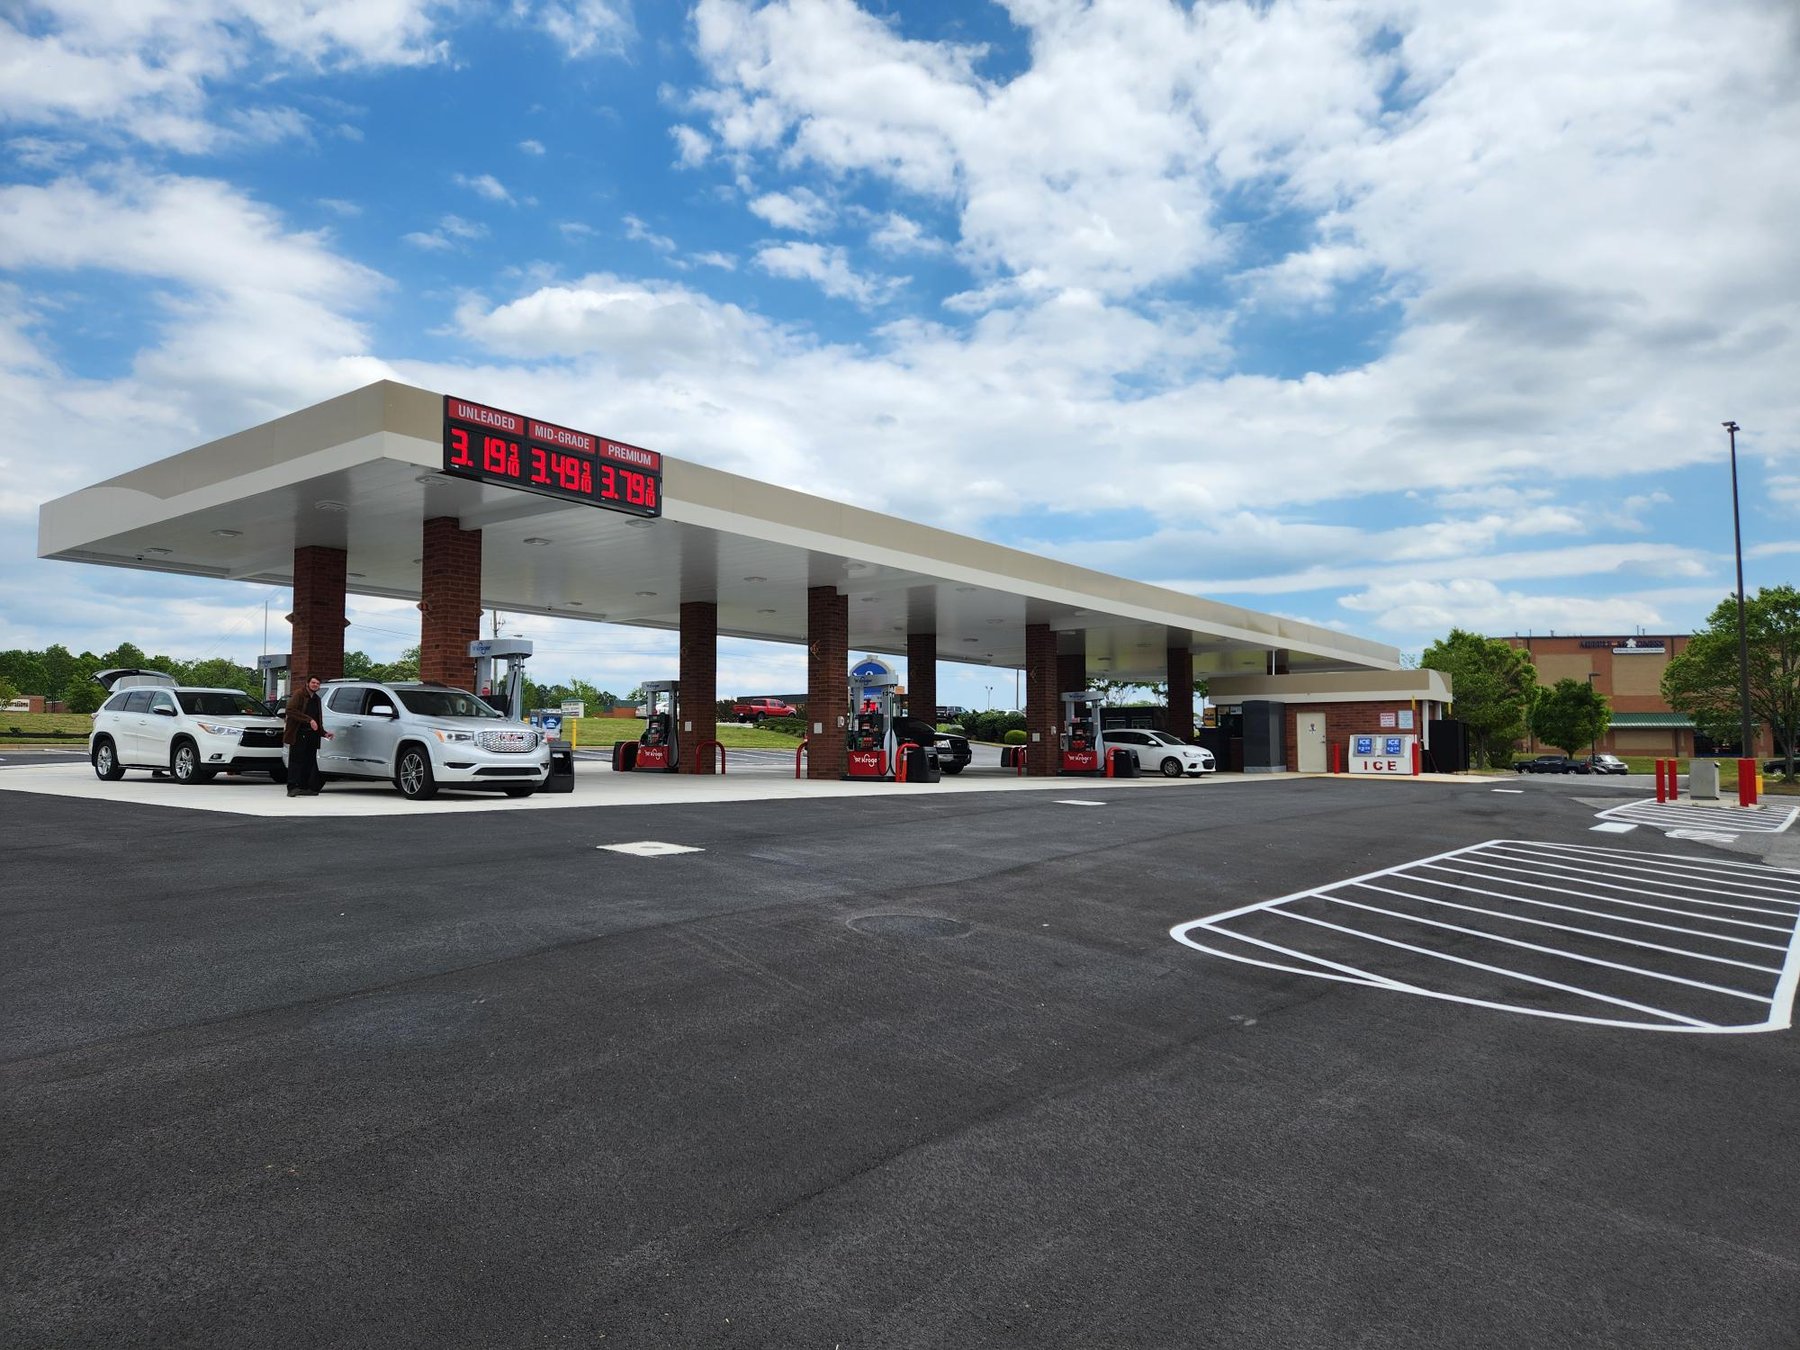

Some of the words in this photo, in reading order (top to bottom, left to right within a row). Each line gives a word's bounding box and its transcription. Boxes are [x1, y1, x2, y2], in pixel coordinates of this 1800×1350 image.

[458, 404, 515, 430] UNLEADED
[534, 425, 590, 450] MID-GRADE
[608, 444, 651, 466] PREMIUM
[1364, 761, 1397, 771] ICE
